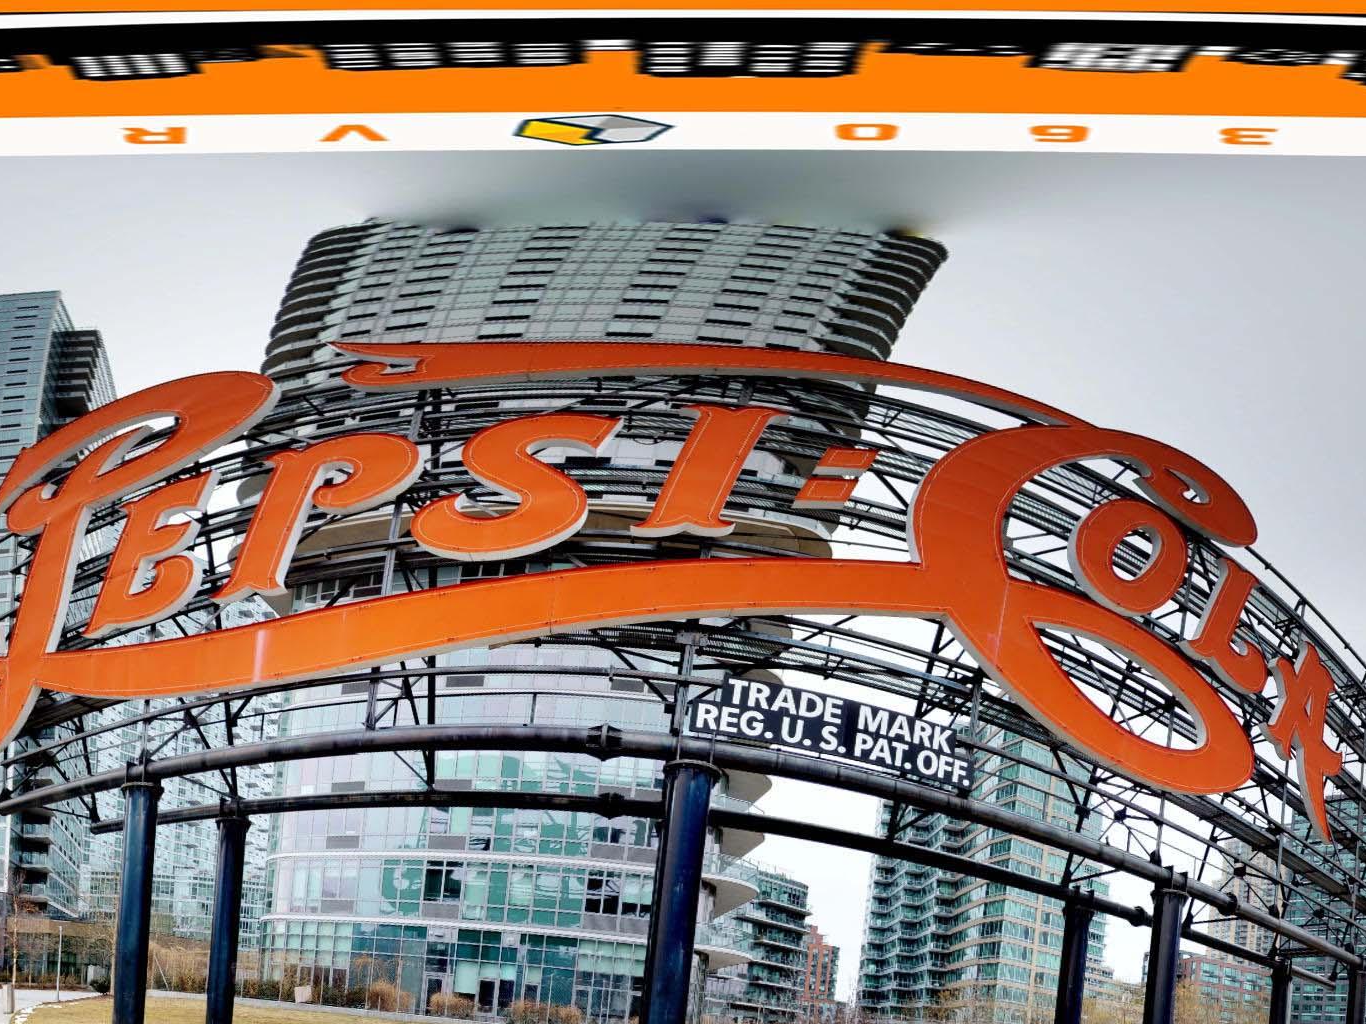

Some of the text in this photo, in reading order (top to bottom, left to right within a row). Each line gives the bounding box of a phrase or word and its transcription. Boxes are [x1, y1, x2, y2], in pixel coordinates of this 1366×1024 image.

[695, 702, 774, 740] REG.
[854, 731, 913, 770] PAT.
[916, 750, 971, 787] OFF.
[728, 678, 953, 754] TRADE MARK
